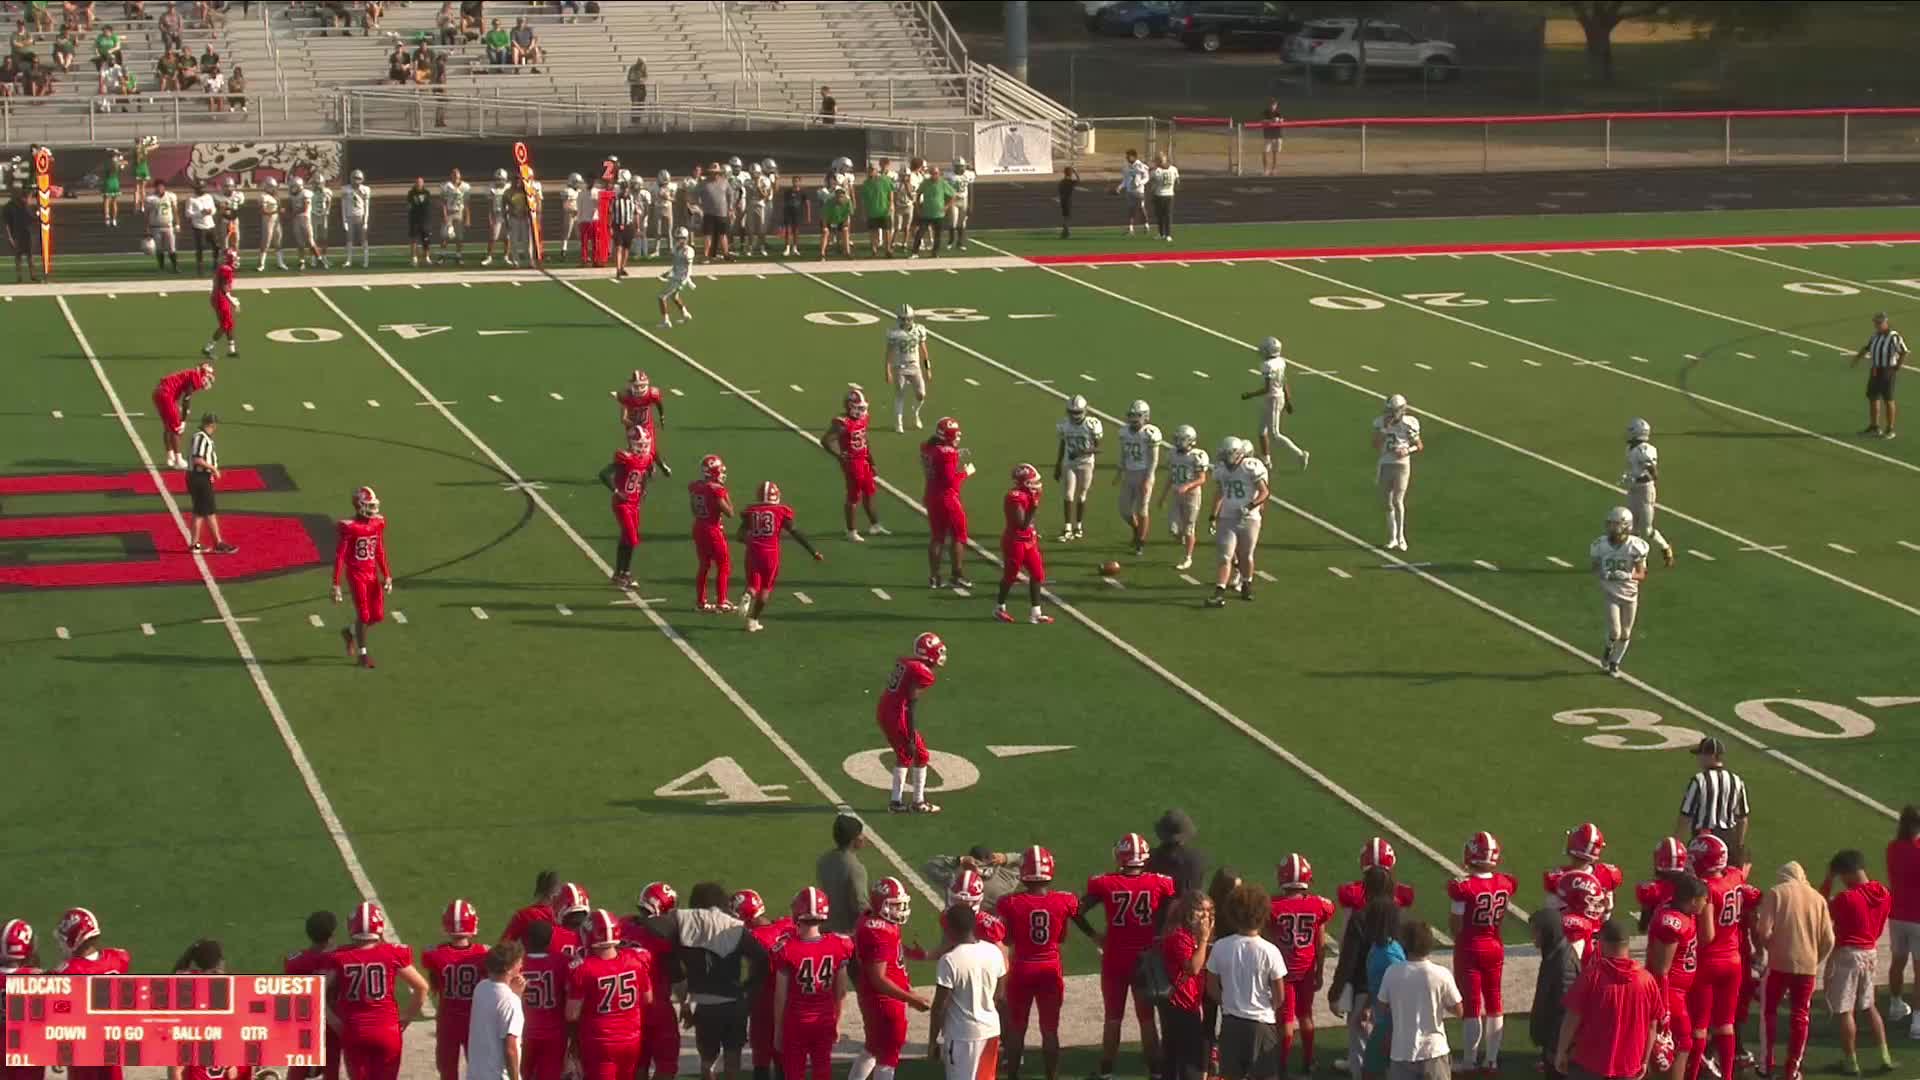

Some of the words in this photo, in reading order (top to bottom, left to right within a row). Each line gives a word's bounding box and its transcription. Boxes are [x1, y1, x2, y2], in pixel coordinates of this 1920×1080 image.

[1224, 480, 1246, 498] 78
[1572, 876, 1597, 895] Cats
[1112, 889, 1152, 927] 74
[1472, 889, 1509, 926] 22
[1028, 908, 1050, 945] 8
[1276, 912, 1317, 949] 35
[343, 962, 386, 1001] 70
[442, 963, 479, 1000] 18
[523, 970, 558, 1010] 51
[597, 970, 637, 1014] 75
[797, 954, 835, 994] 44
